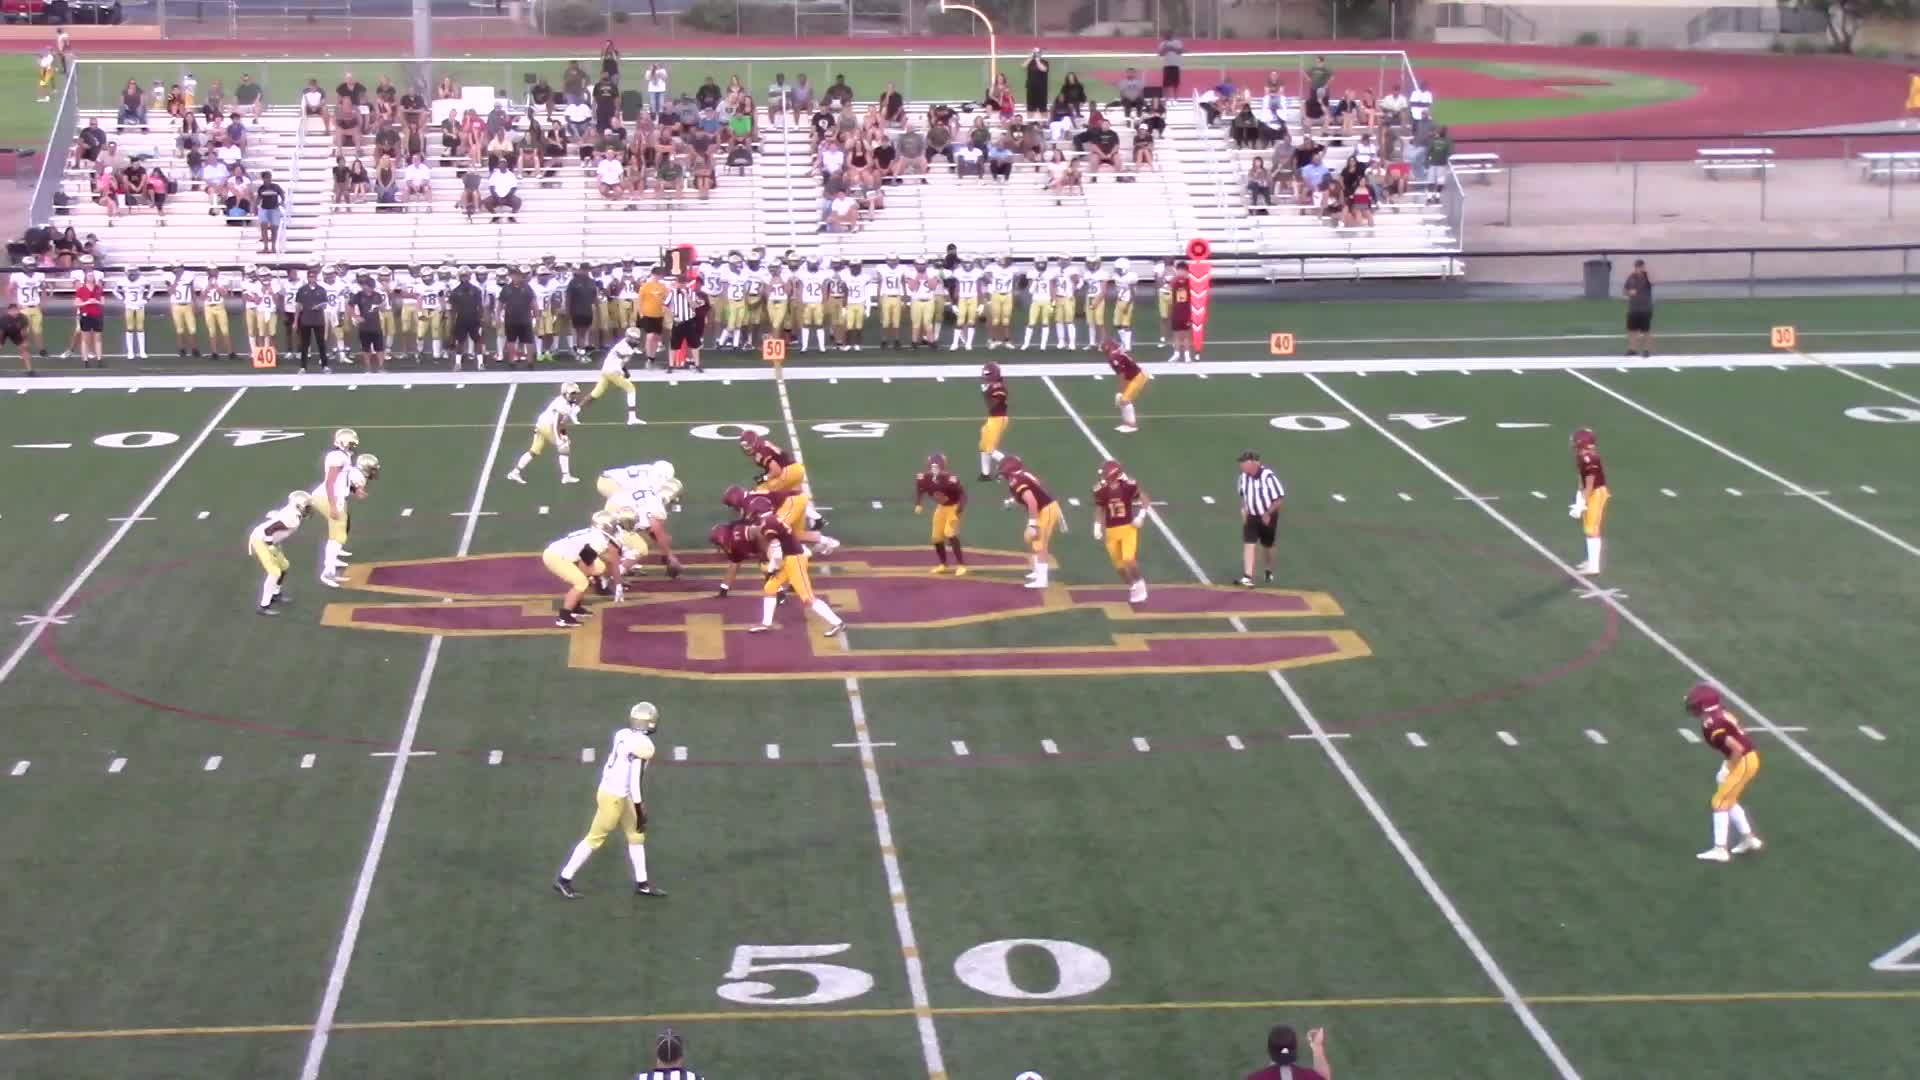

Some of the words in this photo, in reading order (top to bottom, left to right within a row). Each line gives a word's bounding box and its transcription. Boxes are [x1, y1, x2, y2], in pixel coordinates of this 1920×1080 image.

[671, 251, 681, 275] 1
[767, 340, 782, 356] 50
[1274, 335, 1291, 350] 40
[257, 349, 273, 364] 40
